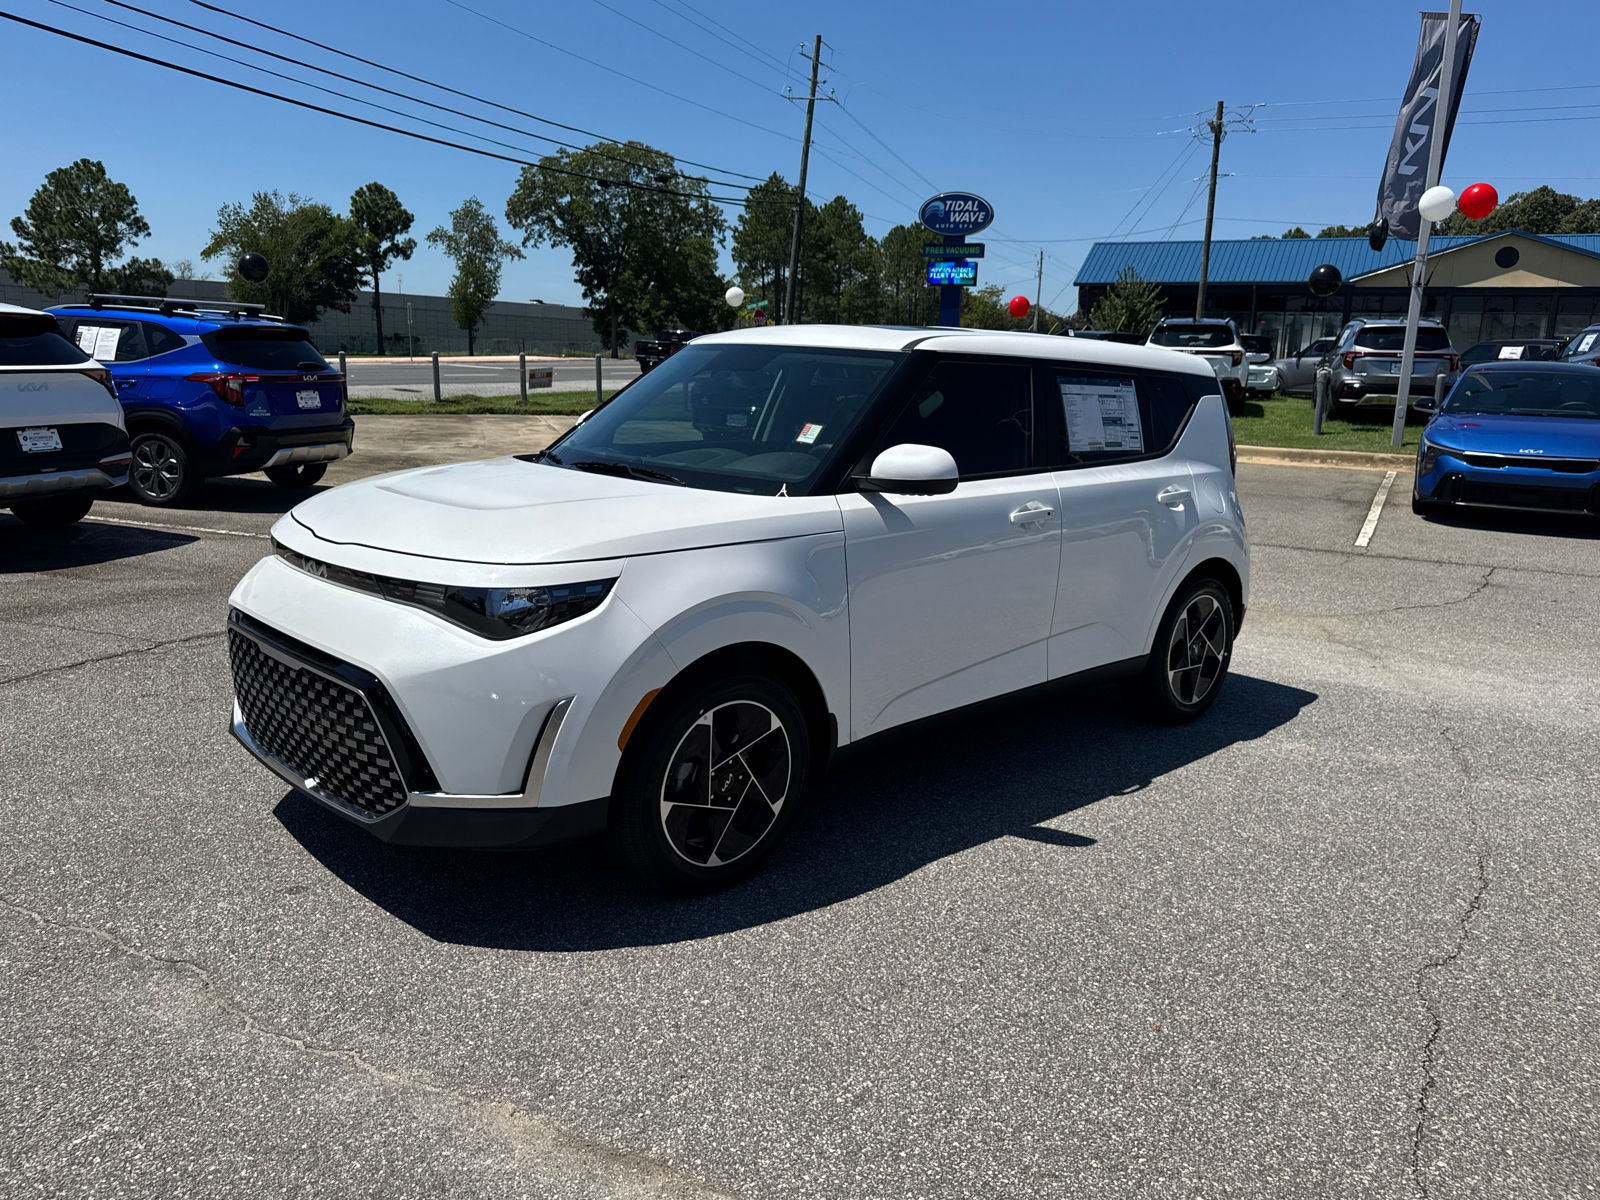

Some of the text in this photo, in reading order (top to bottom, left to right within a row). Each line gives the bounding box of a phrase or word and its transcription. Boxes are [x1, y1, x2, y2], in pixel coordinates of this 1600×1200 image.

[945, 200, 979, 211] TIDAL
[949, 211, 986, 222] WAVE
[925, 246, 980, 254] FREE VACUUMS
[754, 316, 767, 326] STOP
[17, 382, 49, 392] KIA
[301, 556, 328, 578] KIA
